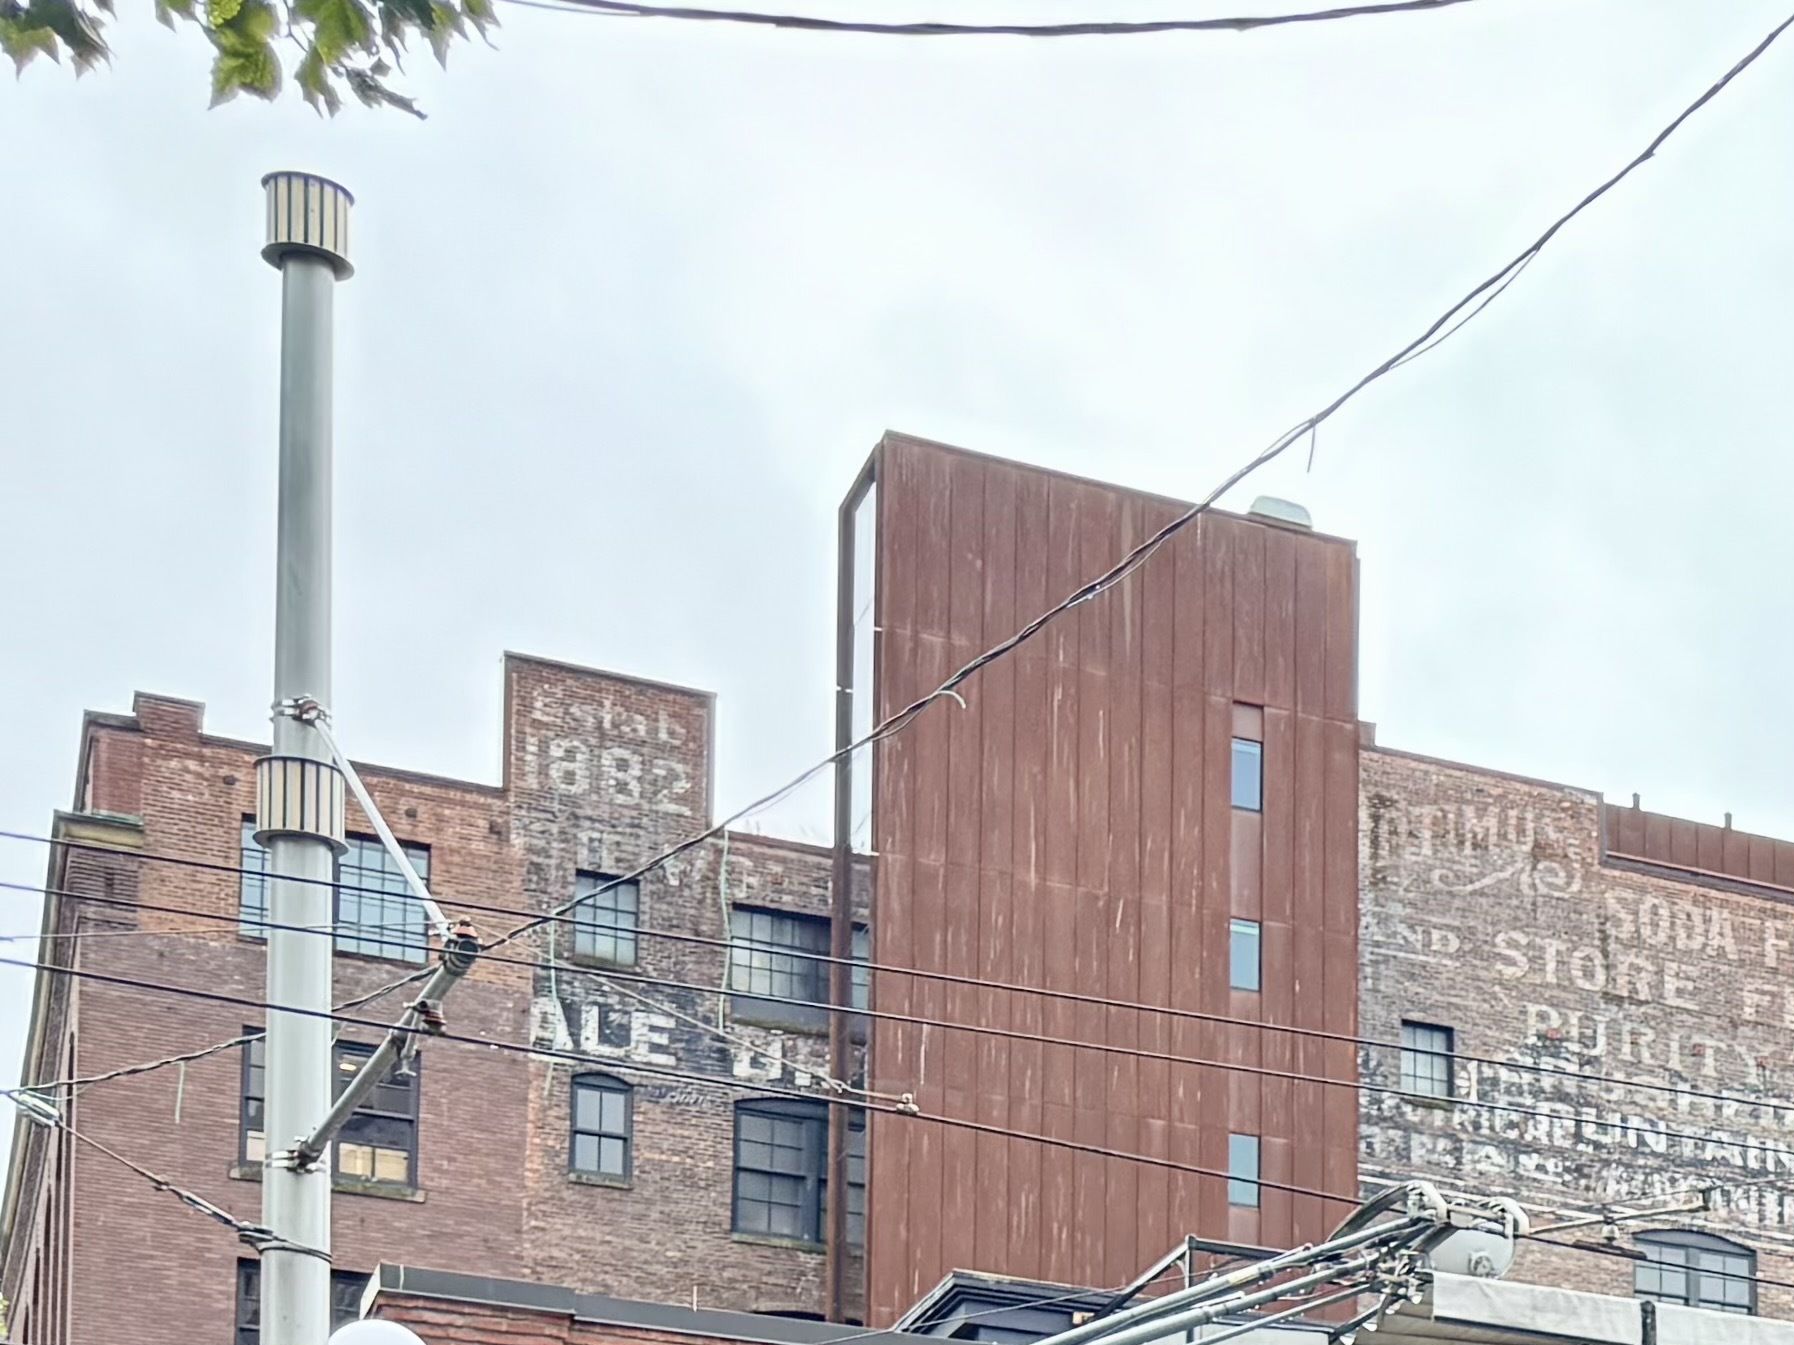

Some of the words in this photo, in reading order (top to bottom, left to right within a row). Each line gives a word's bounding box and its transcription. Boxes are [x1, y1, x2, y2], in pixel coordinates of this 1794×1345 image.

[524, 735, 693, 817] 1882
[1604, 892, 1739, 961] SODA
[1494, 929, 1699, 1002] STORE
[1526, 1002, 1772, 1086] PURITY
